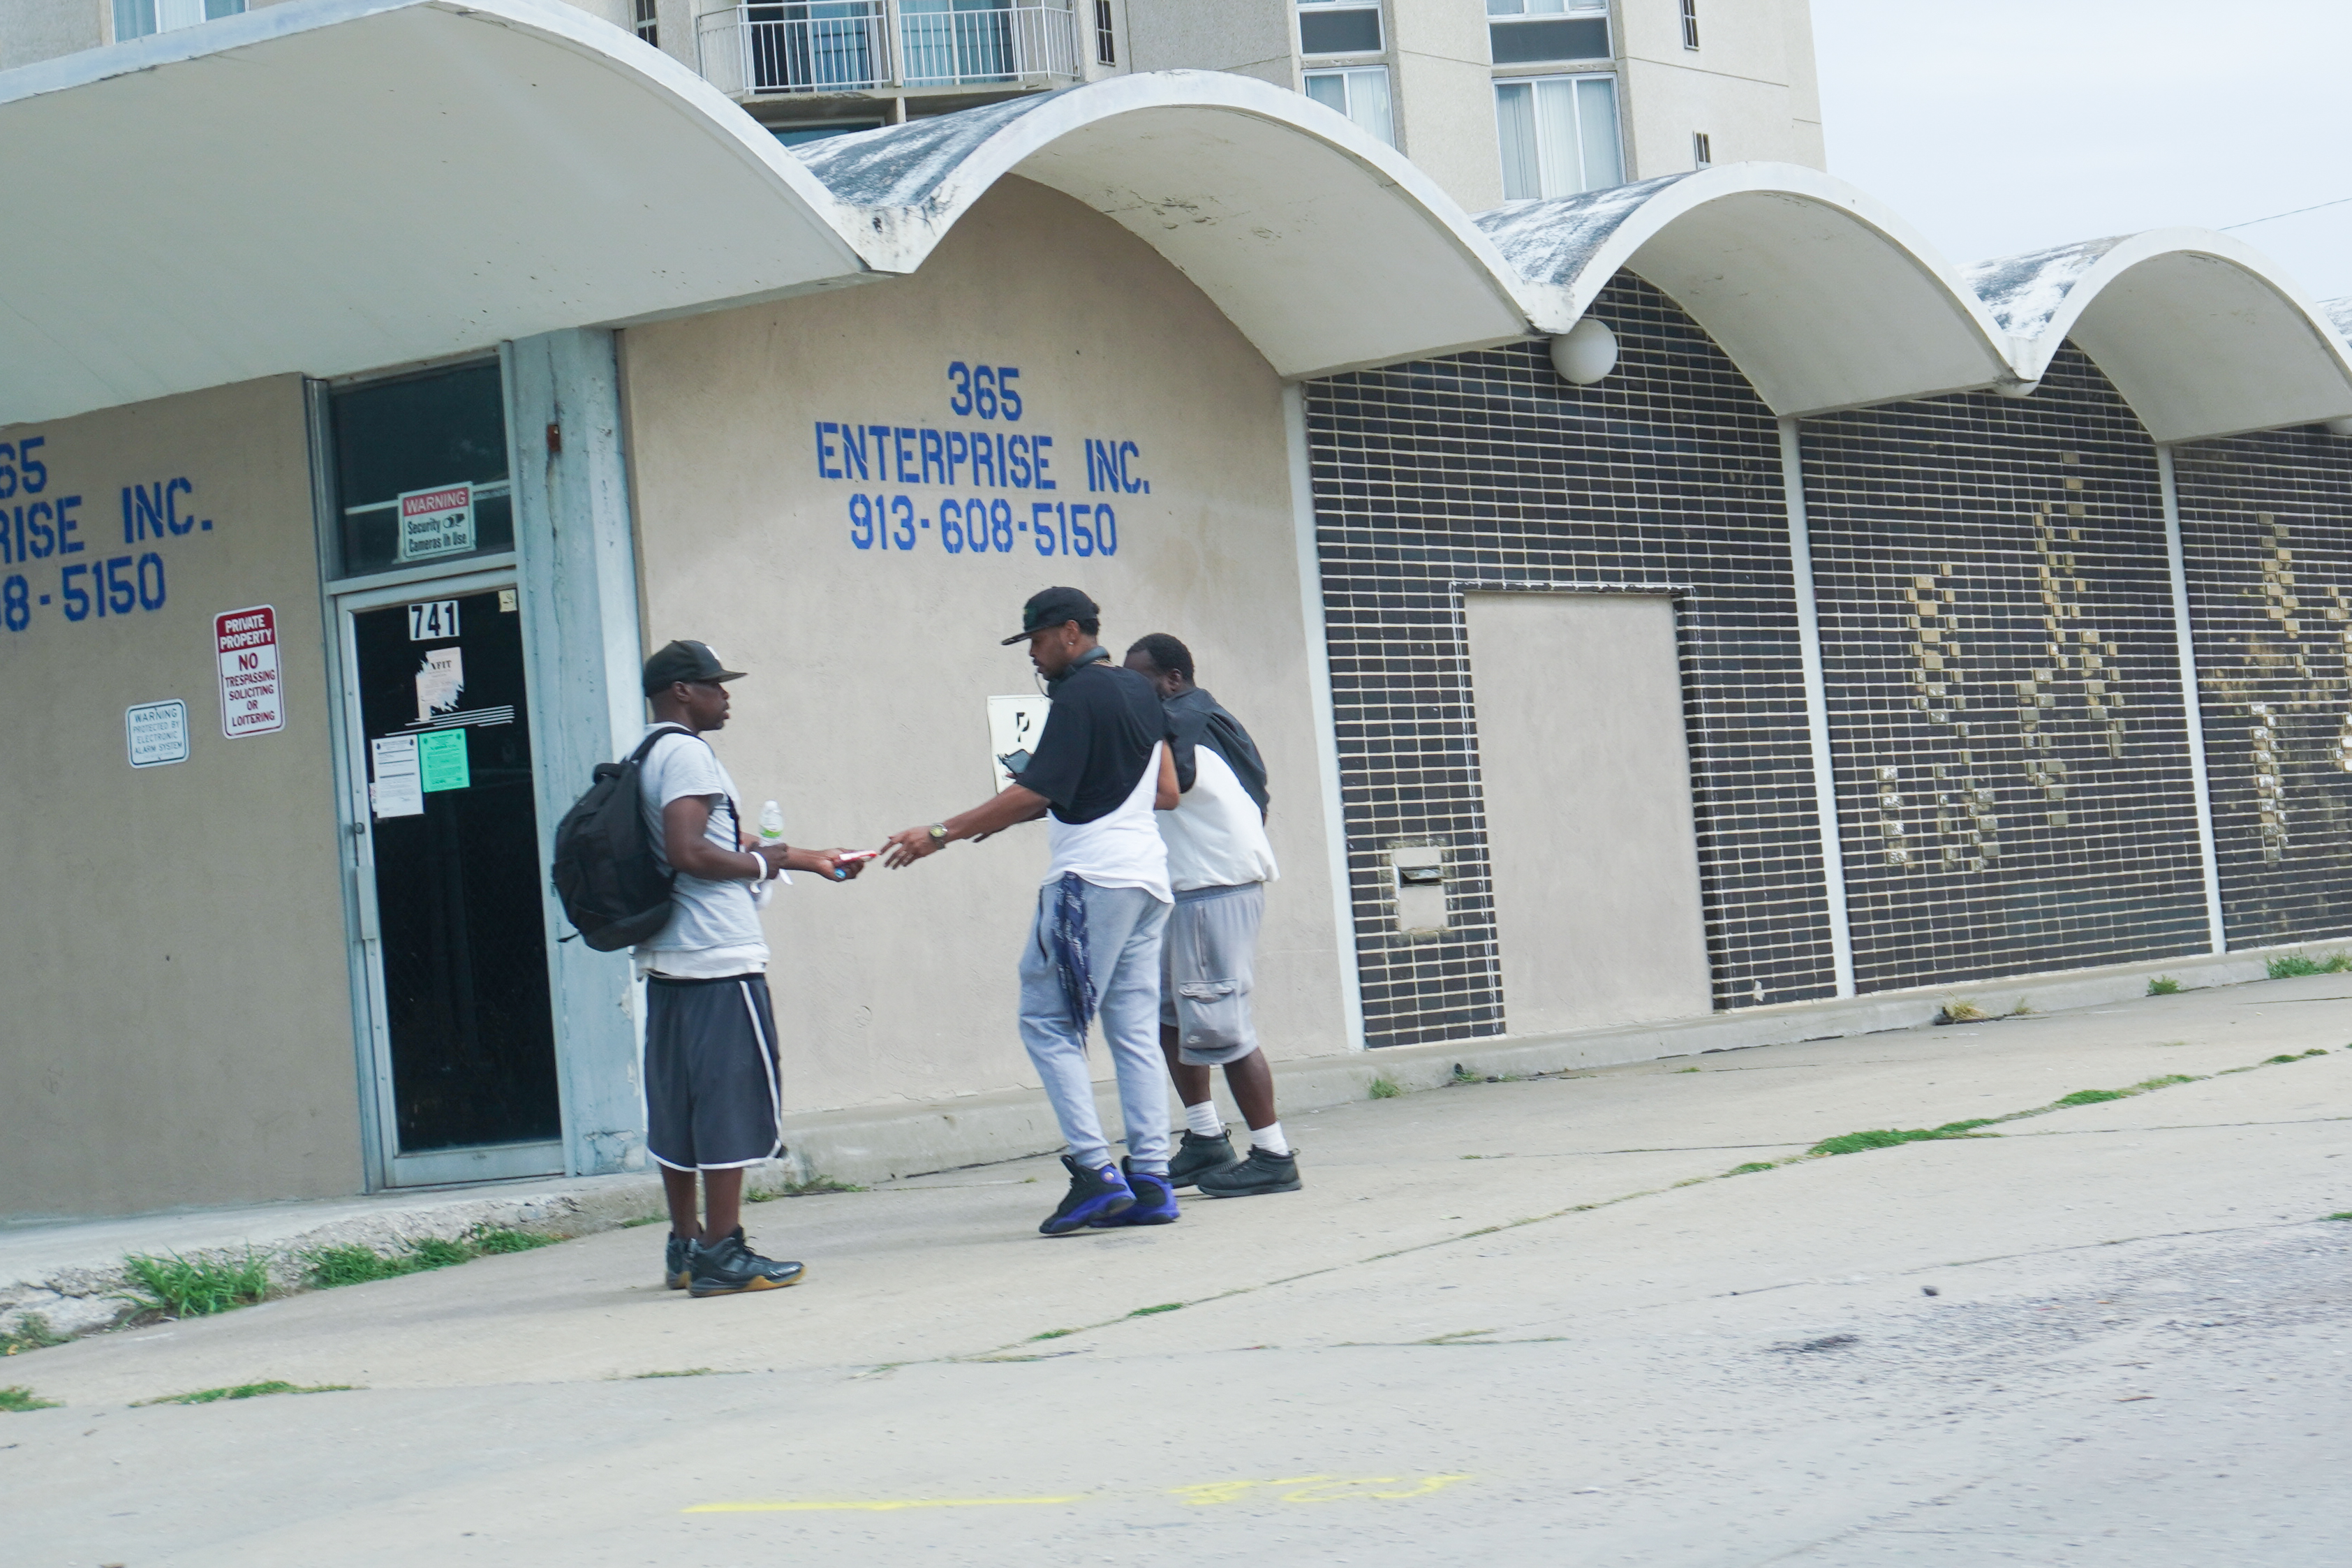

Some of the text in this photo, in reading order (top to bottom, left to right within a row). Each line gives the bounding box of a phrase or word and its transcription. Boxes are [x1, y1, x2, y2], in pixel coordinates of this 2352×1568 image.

[948, 361, 1021, 421] 365
[815, 422, 1150, 494] ENTERPRISE INC.
[121, 477, 213, 543] INC.
[406, 491, 466, 514] WARNING
[408, 517, 441, 535] Security
[849, 494, 1117, 556] 913-608-5150
[409, 538, 442, 552] Cameras
[224, 614, 265, 634] PRIVATE
[411, 602, 455, 639] 741
[220, 628, 273, 650] PROPERTY
[238, 652, 259, 672] NO
[225, 669, 276, 688] TRESPASSING
[228, 684, 274, 701] SOLICITING
[134, 708, 178, 723] WARNING
[246, 700, 258, 711] OR
[232, 711, 276, 727] LOITERING
